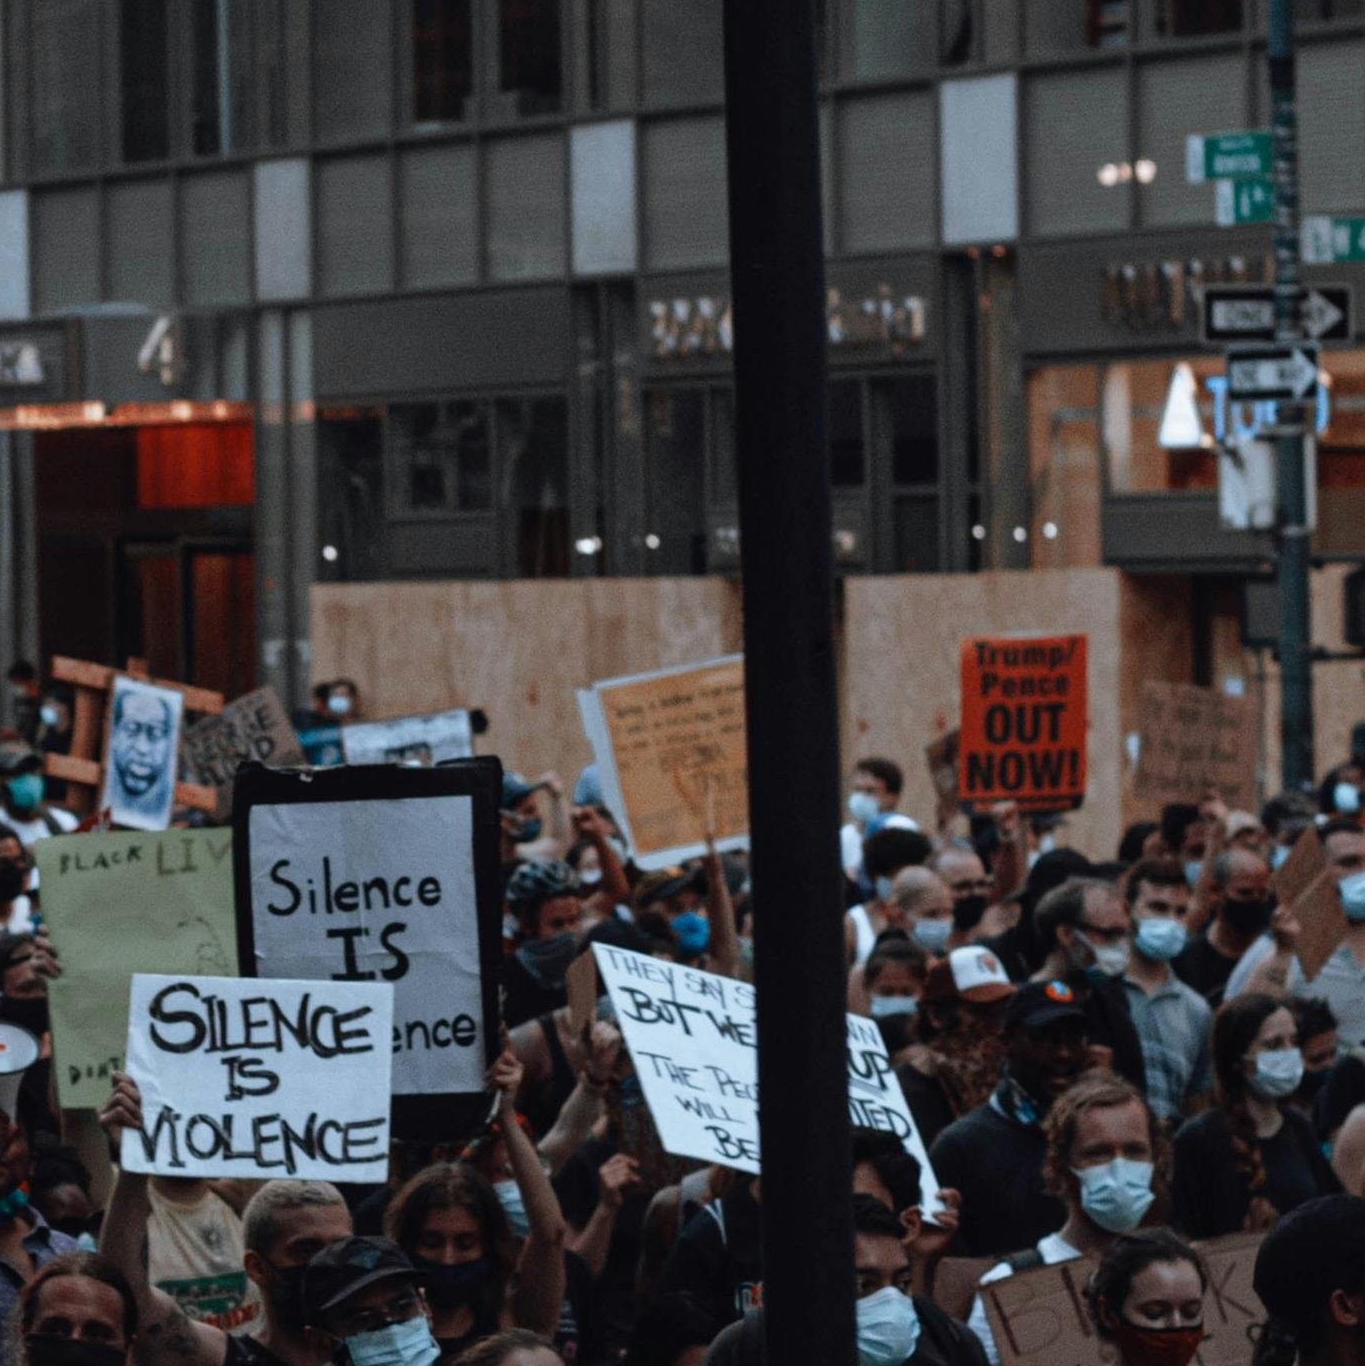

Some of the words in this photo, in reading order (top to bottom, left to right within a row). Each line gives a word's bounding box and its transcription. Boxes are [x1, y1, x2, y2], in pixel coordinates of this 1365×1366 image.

[974, 638, 1076, 669] Trump/
[981, 671, 1070, 697] Pence
[986, 703, 1066, 744] OUT
[967, 750, 1078, 791] NOW!
[60, 844, 143, 875] BLACK
[268, 856, 442, 916] Silence
[327, 922, 409, 981] IS
[605, 949, 678, 1003] THEY
[685, 971, 728, 1009] SAY
[149, 983, 373, 1058] SILENCE
[618, 985, 701, 1037] BUT
[221, 1056, 280, 1101] IS
[636, 1050, 707, 1092] THE
[674, 1095, 746, 1126] WILL
[137, 1104, 389, 1175] VIOLENCE
